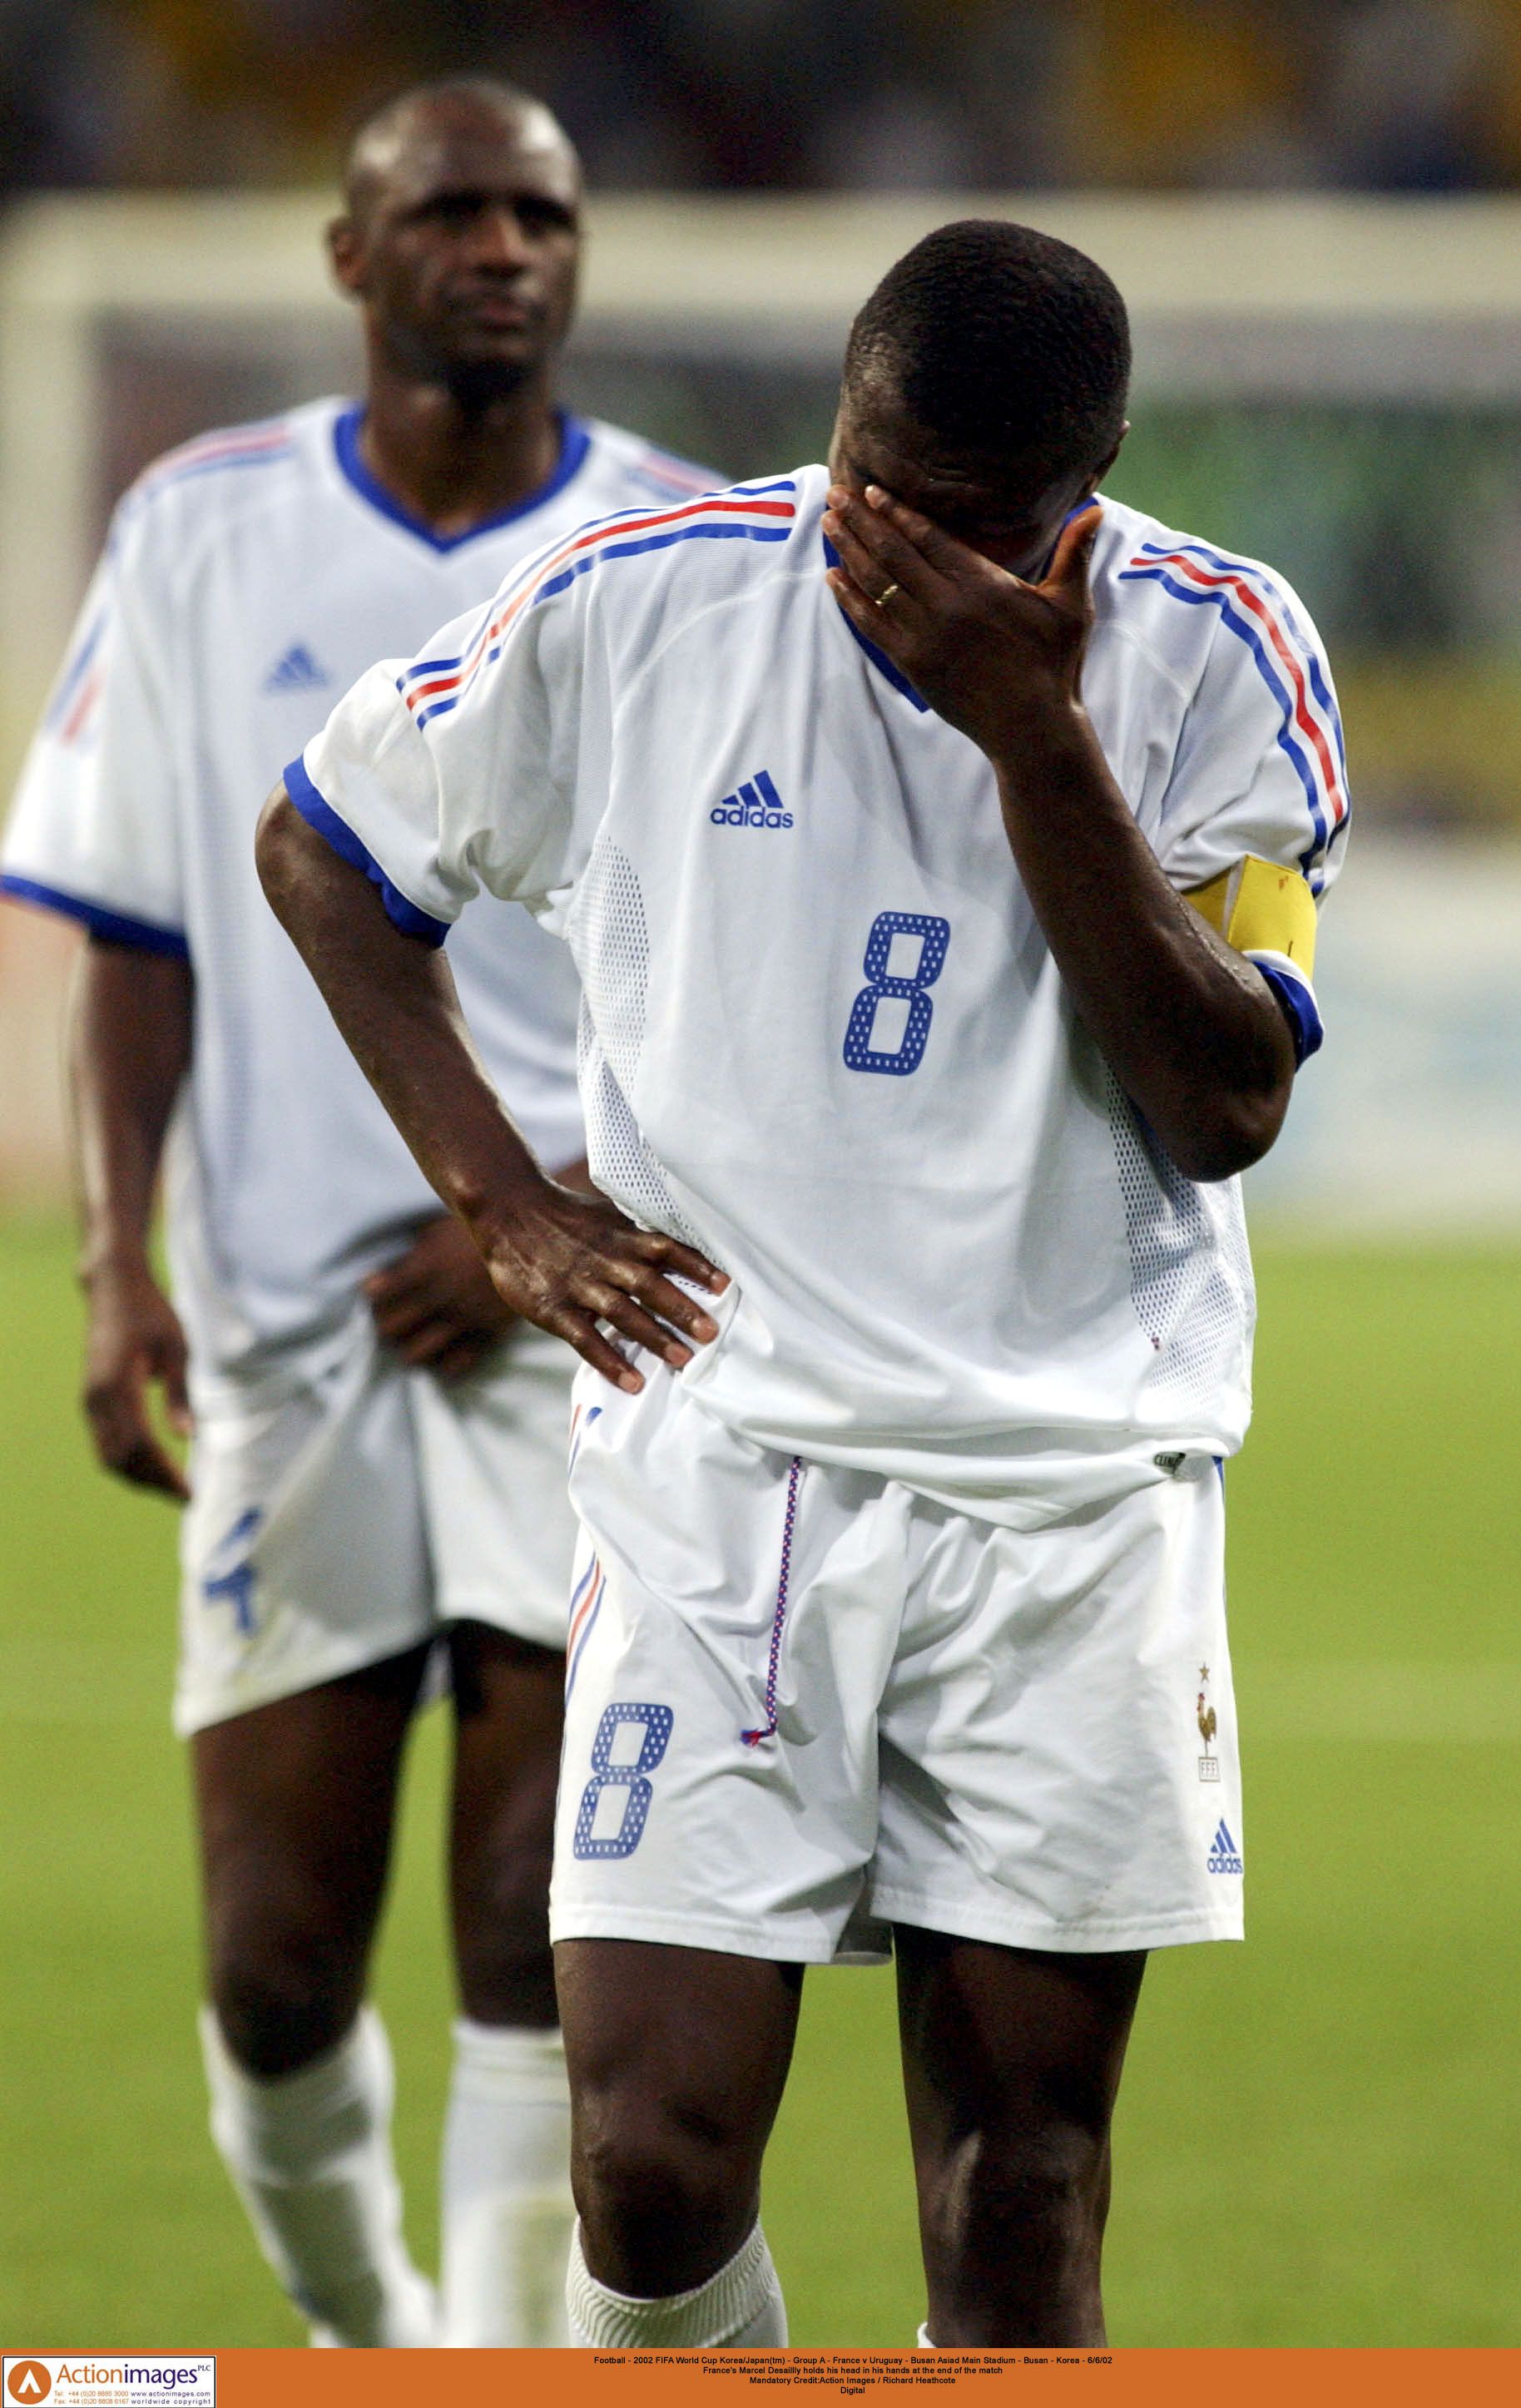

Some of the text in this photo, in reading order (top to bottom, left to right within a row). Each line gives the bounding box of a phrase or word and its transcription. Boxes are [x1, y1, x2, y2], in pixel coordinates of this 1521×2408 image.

[711, 805, 794, 830] adidas
[843, 911, 951, 1076] 8
[573, 1702, 674, 1861] 8
[1207, 1853, 1243, 1873] adidas
